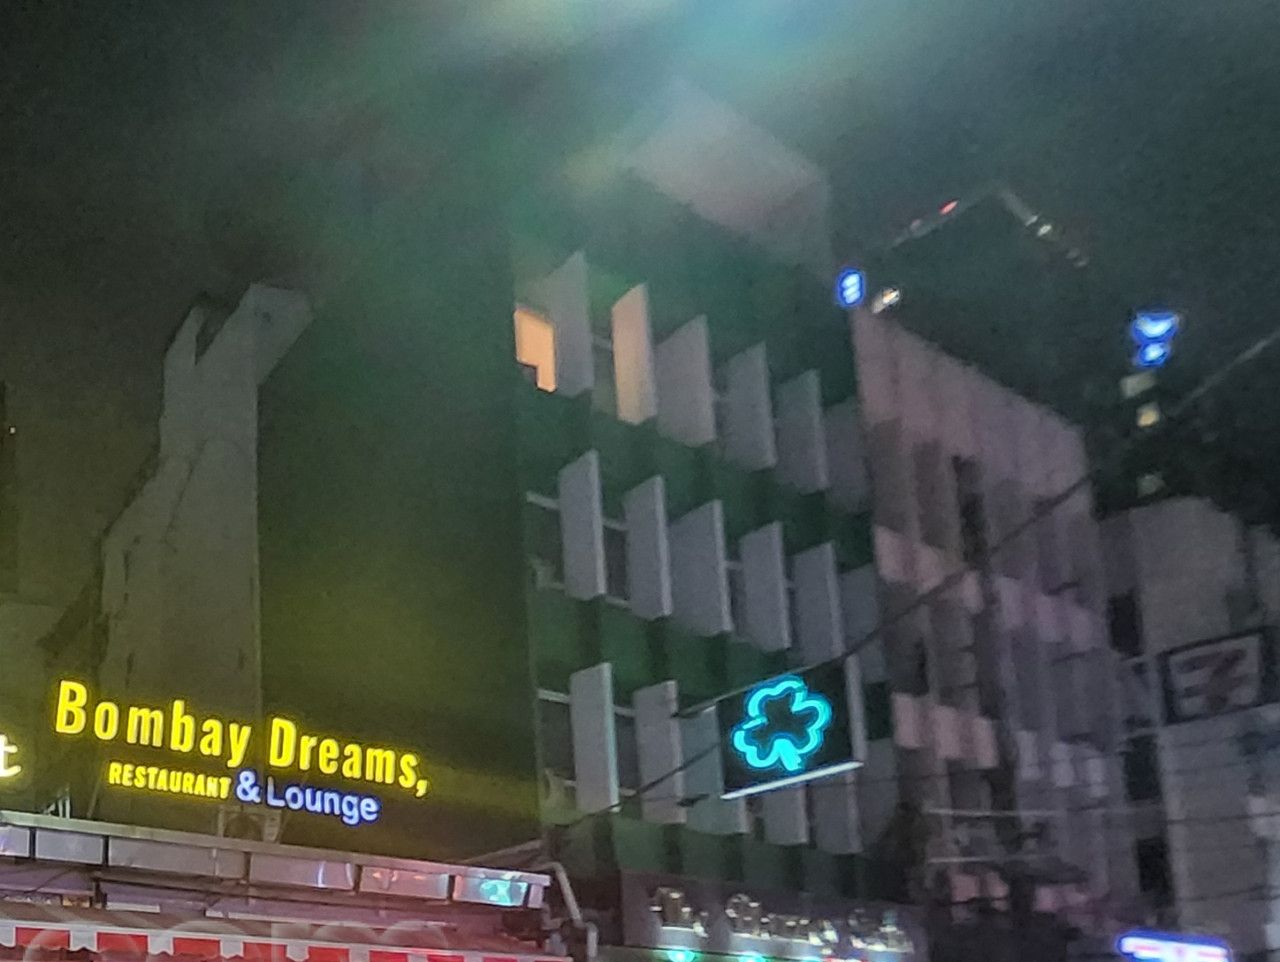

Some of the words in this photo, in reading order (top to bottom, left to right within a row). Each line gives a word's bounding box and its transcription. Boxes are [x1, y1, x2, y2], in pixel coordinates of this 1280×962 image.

[55, 680, 252, 768] Bombay
[269, 717, 429, 798] Dreams,
[109, 762, 232, 799] RESTAURANT
[234, 769, 261, 803] &
[266, 776, 380, 825] Lounge
